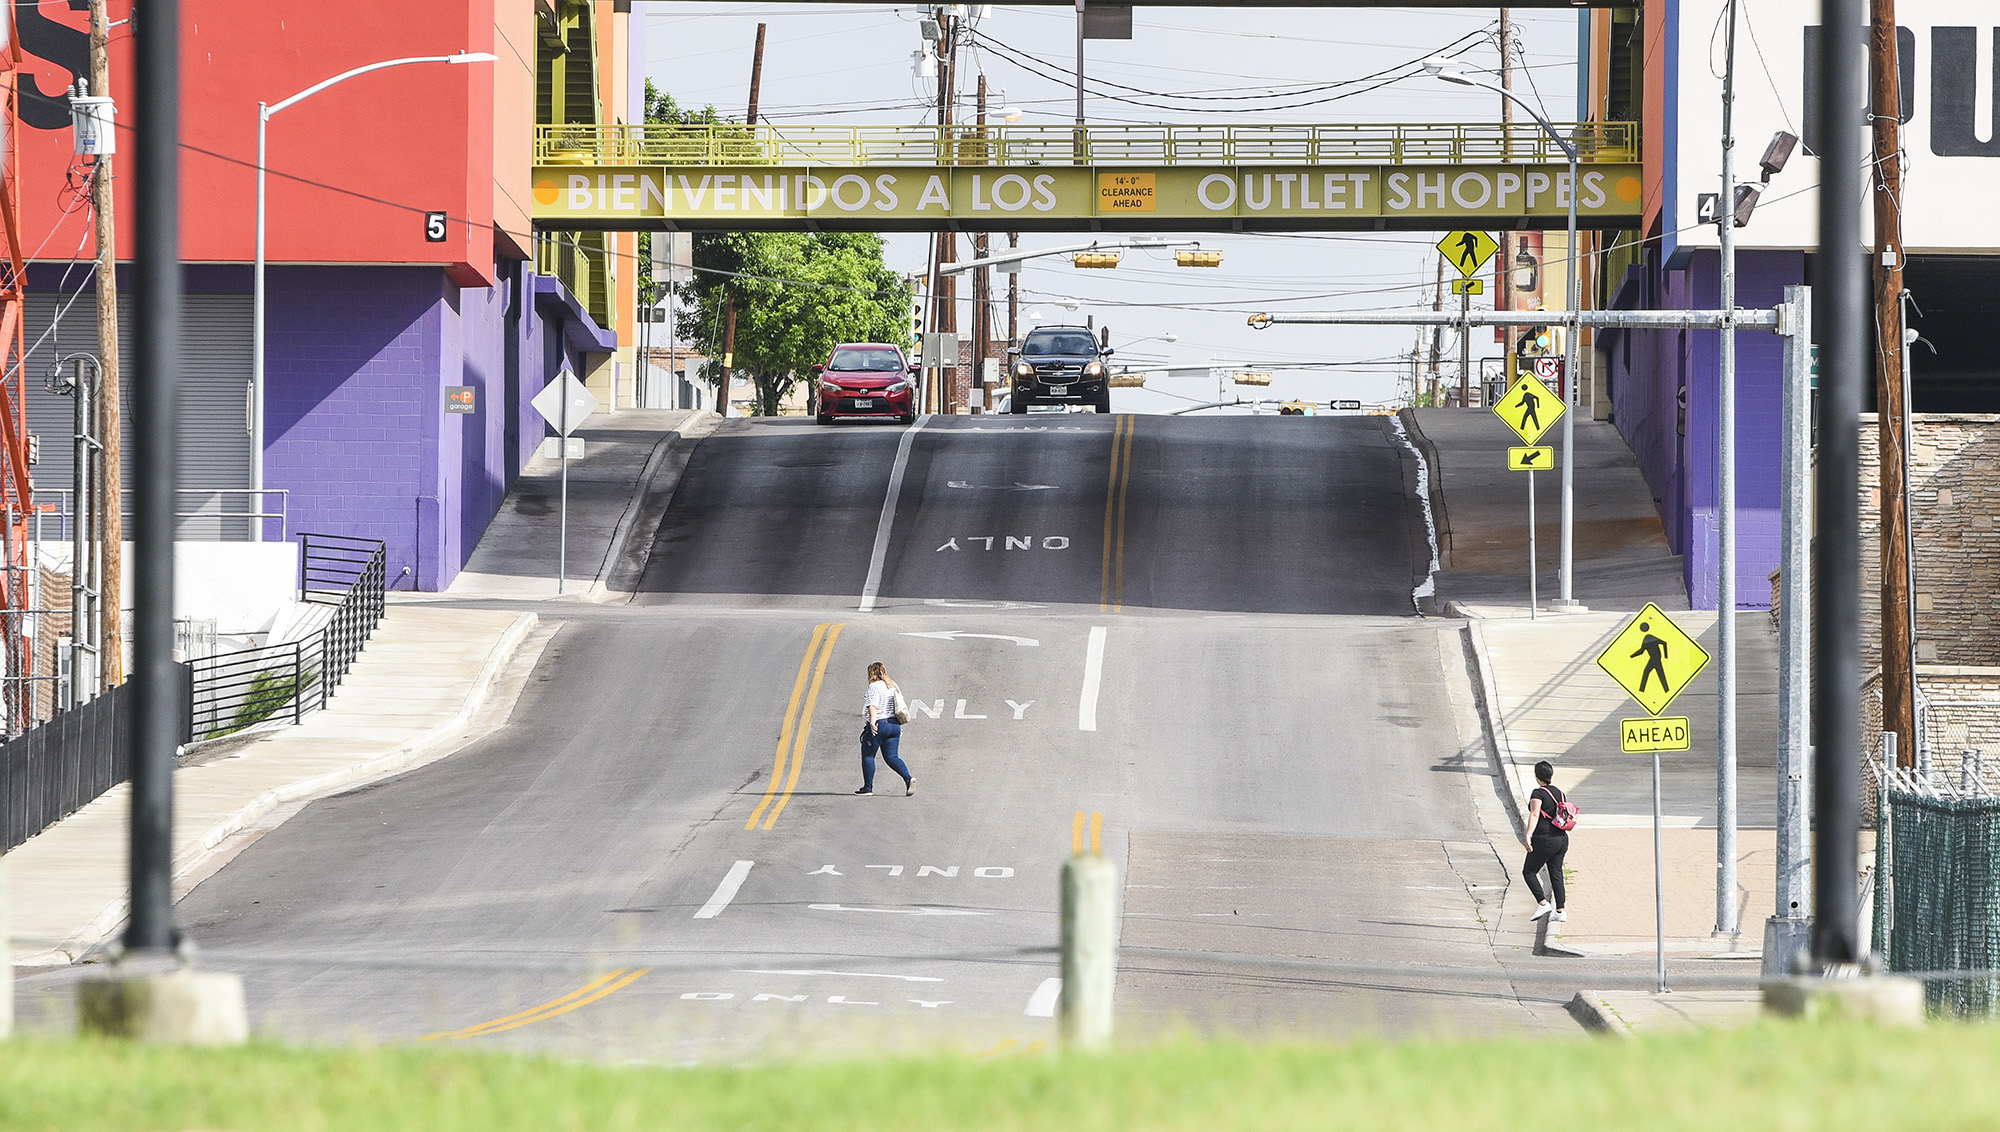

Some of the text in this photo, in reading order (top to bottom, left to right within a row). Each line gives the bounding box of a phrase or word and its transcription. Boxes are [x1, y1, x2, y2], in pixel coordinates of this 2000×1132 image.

[568, 174, 1057, 211] BIENVENIDOS A LOS
[1101, 188, 1153, 196] CLEARANCE
[1197, 171, 1606, 211] OUTLET SHOPPES
[1112, 199, 1143, 208] AHEAD
[1699, 196, 1715, 221] 4
[427, 214, 445, 239] 5
[936, 535, 1070, 552] ONLY
[908, 698, 1036, 720] NLY
[1626, 726, 1685, 744] AHEAD
[805, 864, 1015, 878] ONLY
[680, 992, 956, 1008] ONLY
